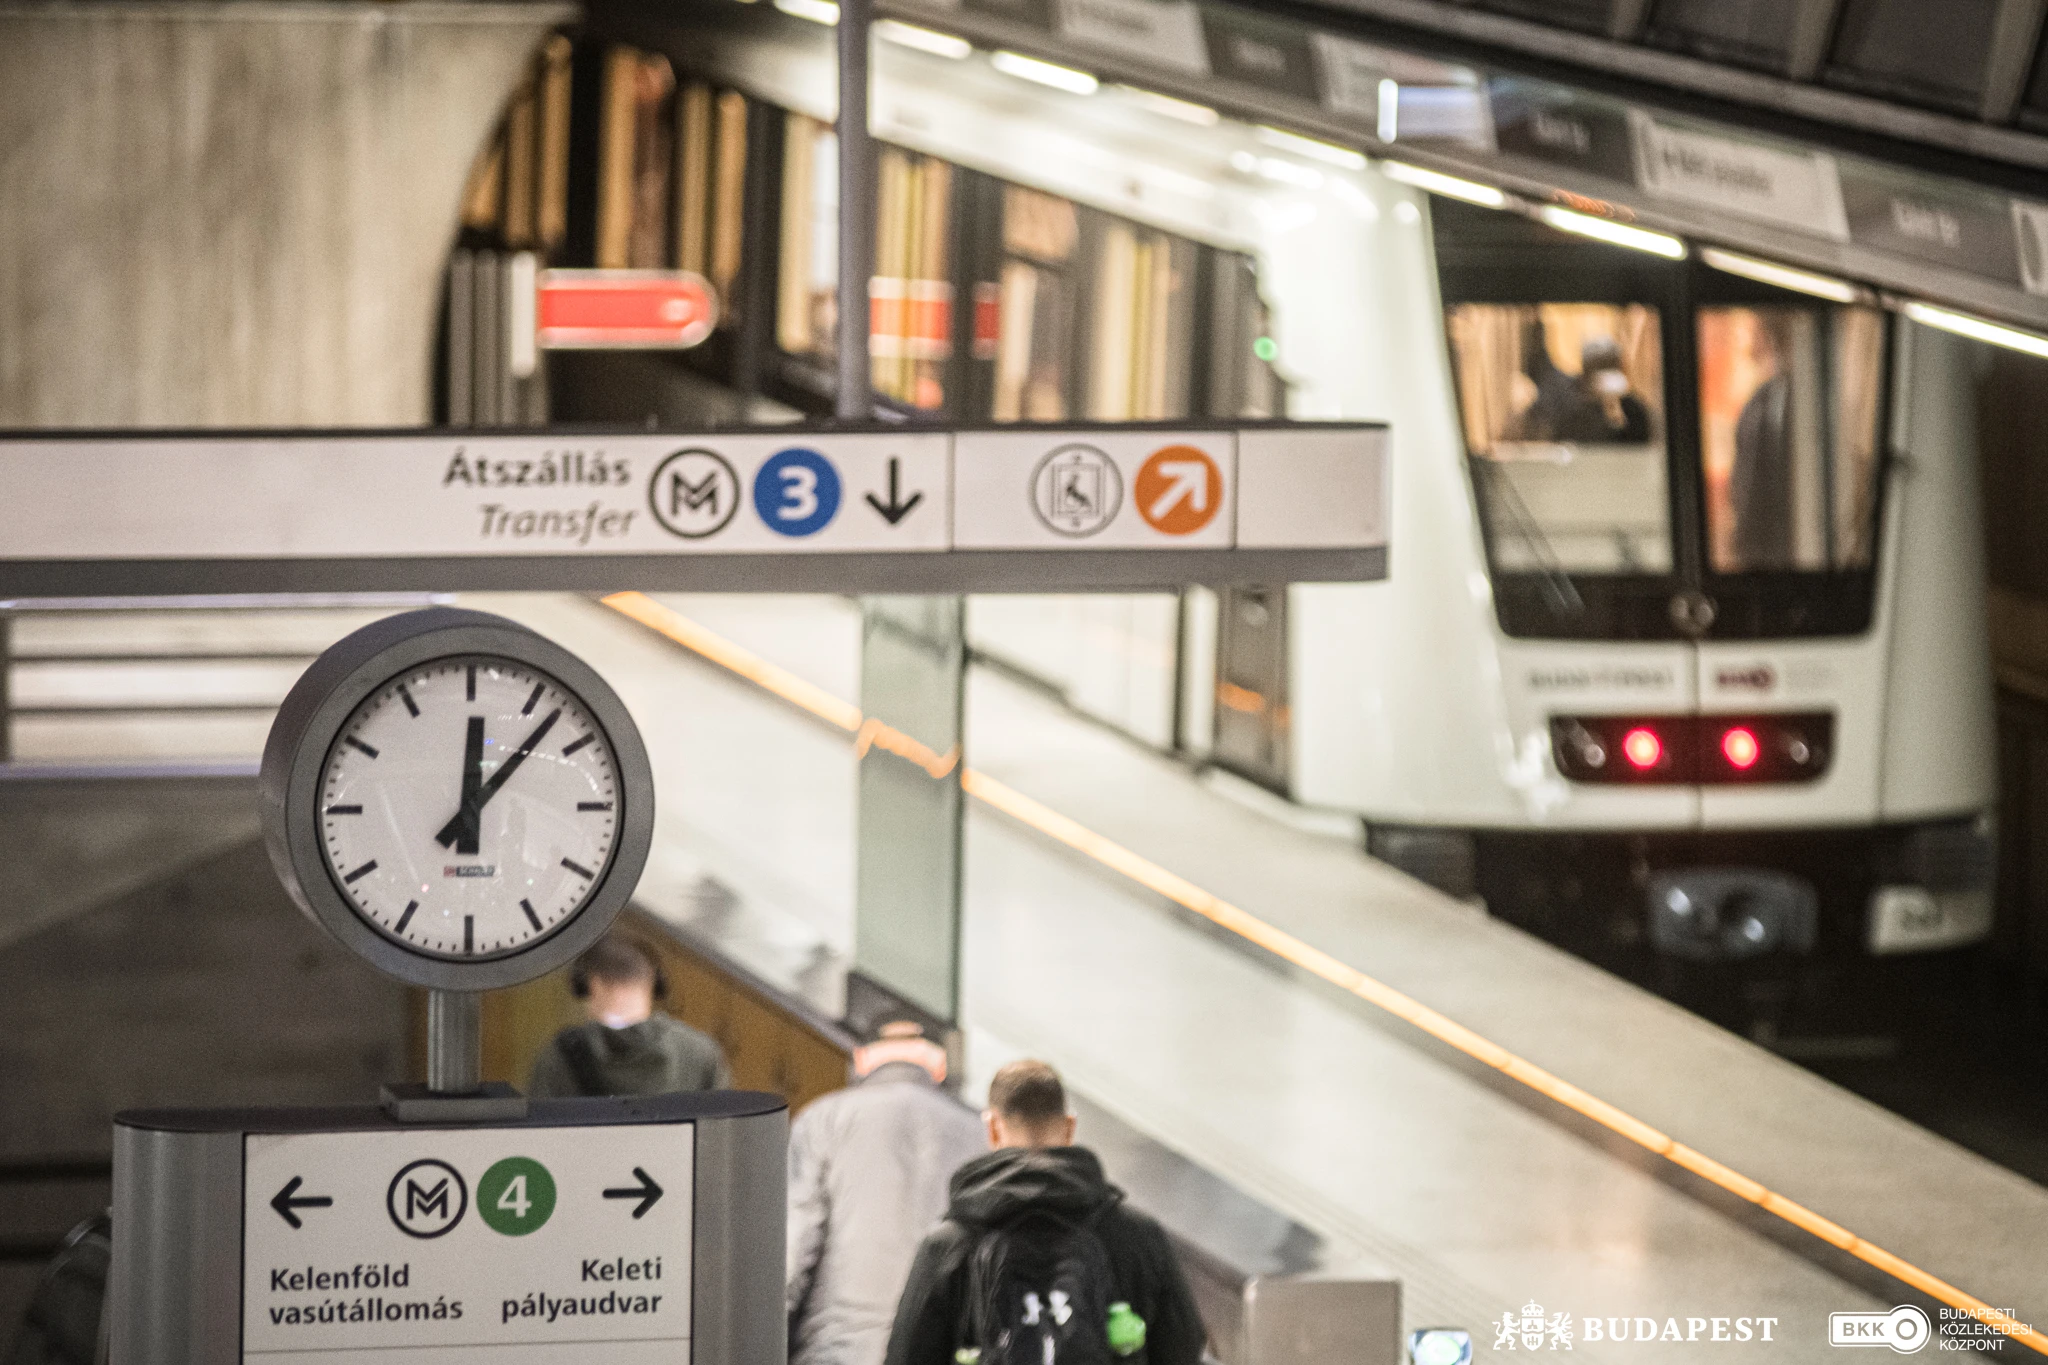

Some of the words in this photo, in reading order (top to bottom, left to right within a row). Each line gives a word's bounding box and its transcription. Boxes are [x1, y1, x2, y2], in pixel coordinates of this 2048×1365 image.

[440, 445, 631, 488] Átszállás
[777, 466, 819, 521] 3
[479, 502, 638, 546] Transfer
[496, 1174, 532, 1218] 4
[269, 1263, 410, 1291] Kelenföld
[581, 1257, 663, 1282] Keleti
[269, 1296, 463, 1325] vasútállomás
[501, 1291, 663, 1324] pályaudvar
